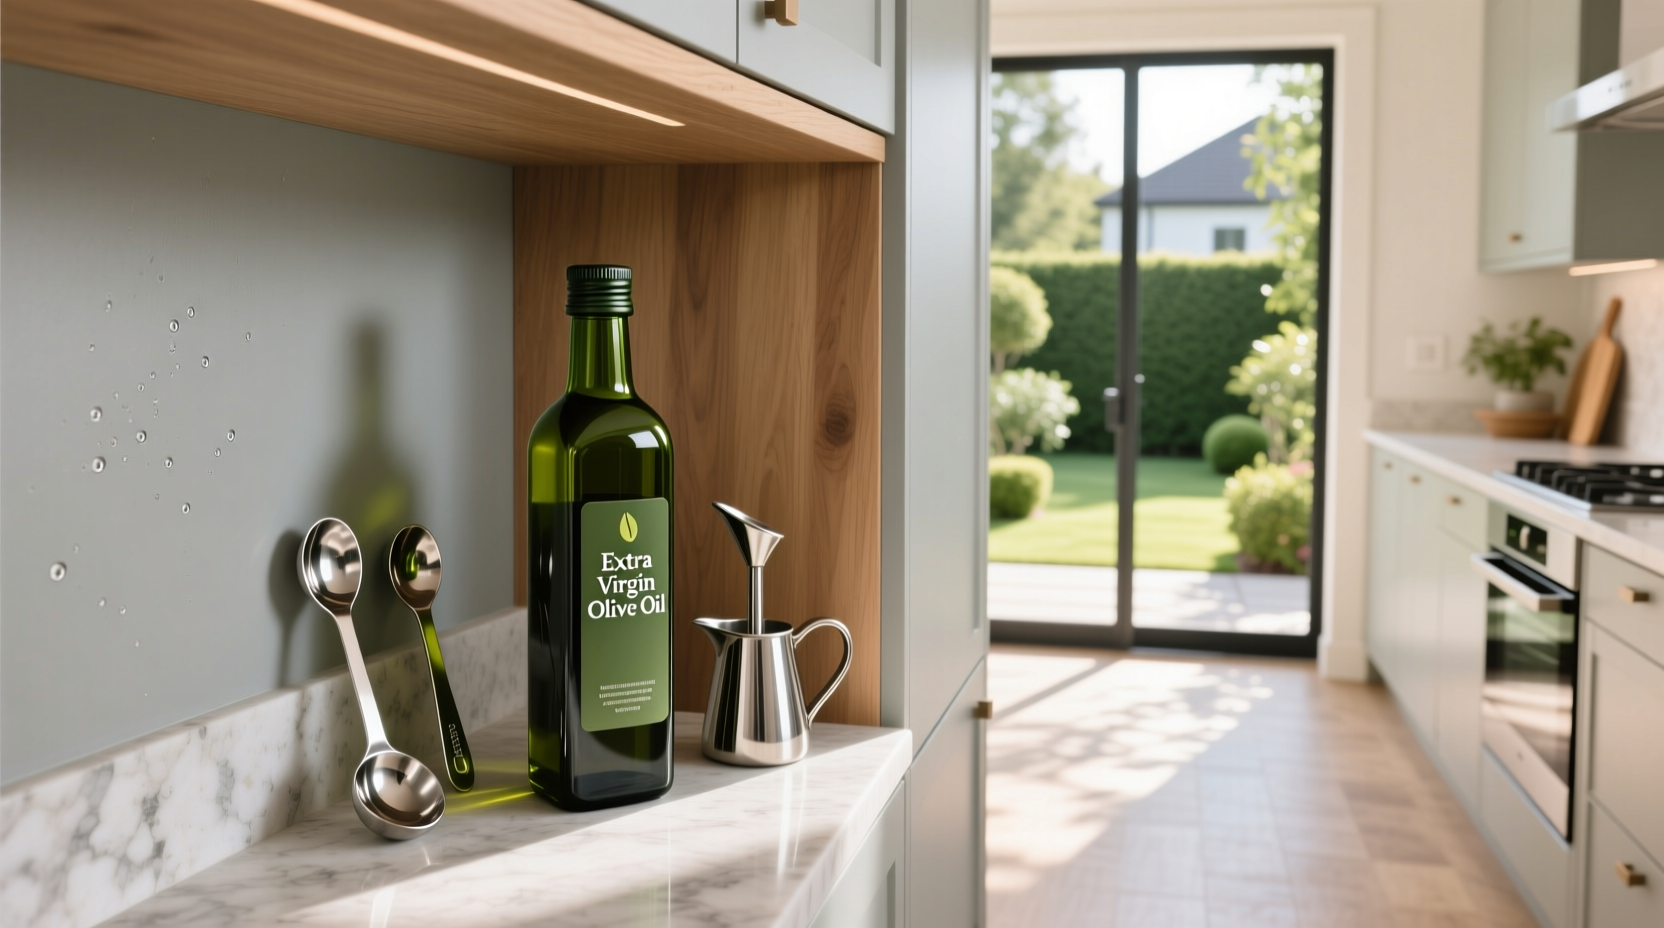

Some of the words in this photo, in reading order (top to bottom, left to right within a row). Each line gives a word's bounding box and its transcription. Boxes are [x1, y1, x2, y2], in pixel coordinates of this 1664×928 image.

[601, 552, 652, 572] Extra
[597, 573, 655, 598] Virgin
[588, 599, 637, 619] Olive
[640, 594, 666, 615] Oil
